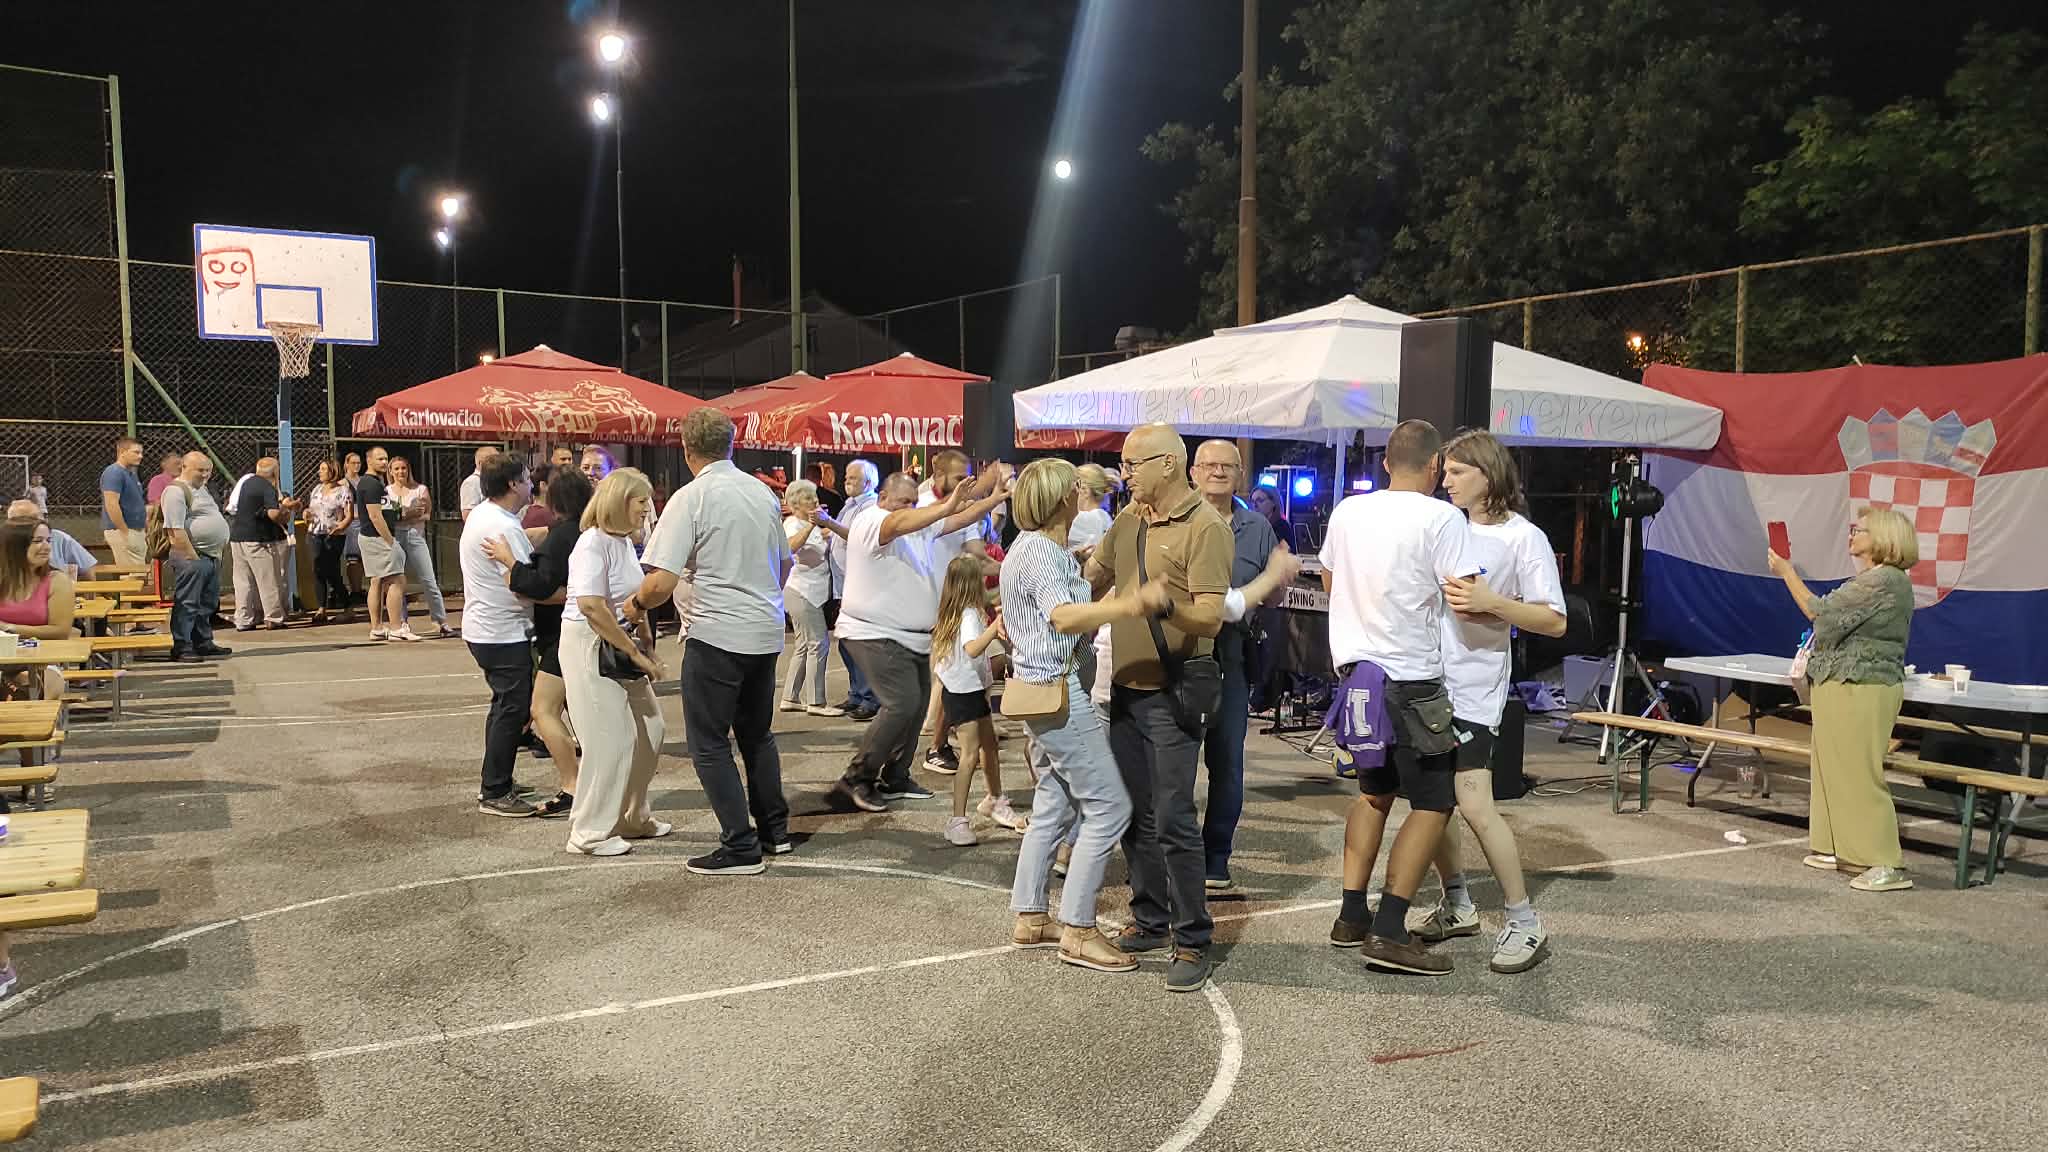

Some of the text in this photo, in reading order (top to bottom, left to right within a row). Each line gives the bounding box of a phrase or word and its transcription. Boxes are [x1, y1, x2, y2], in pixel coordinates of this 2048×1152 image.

[397, 407, 483, 427] Karlovačko
[827, 411, 963, 446] Karlovač
[1288, 591, 1315, 607] SWING
